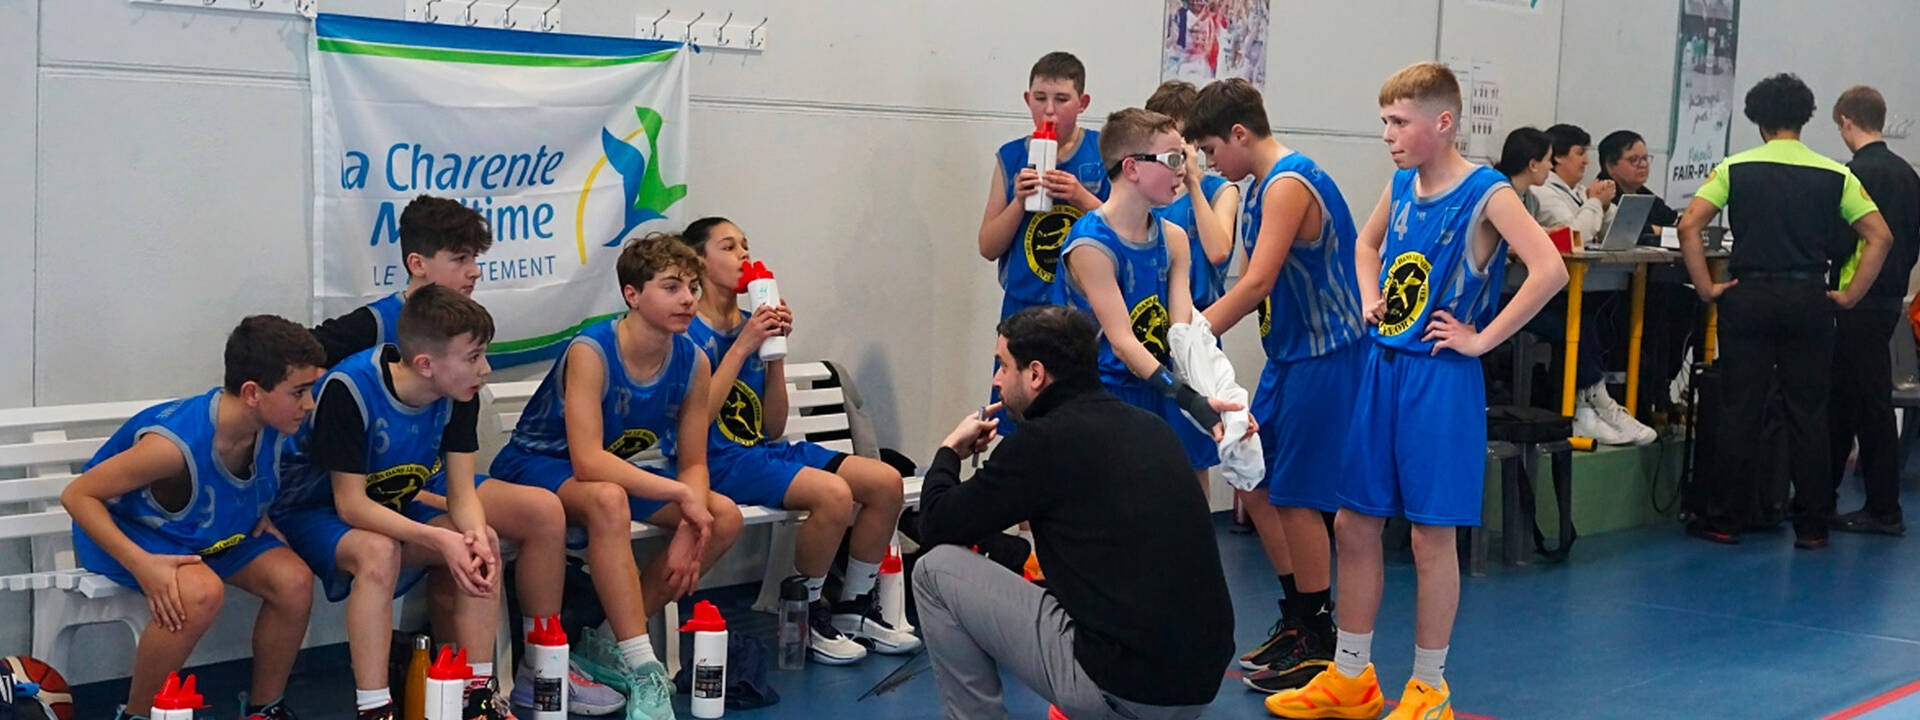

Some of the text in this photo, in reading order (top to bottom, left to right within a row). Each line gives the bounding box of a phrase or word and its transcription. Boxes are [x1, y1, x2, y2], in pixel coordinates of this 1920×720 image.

[385, 143, 564, 191] Charente
[373, 265, 397, 286] LE
[375, 417, 390, 455] 6
